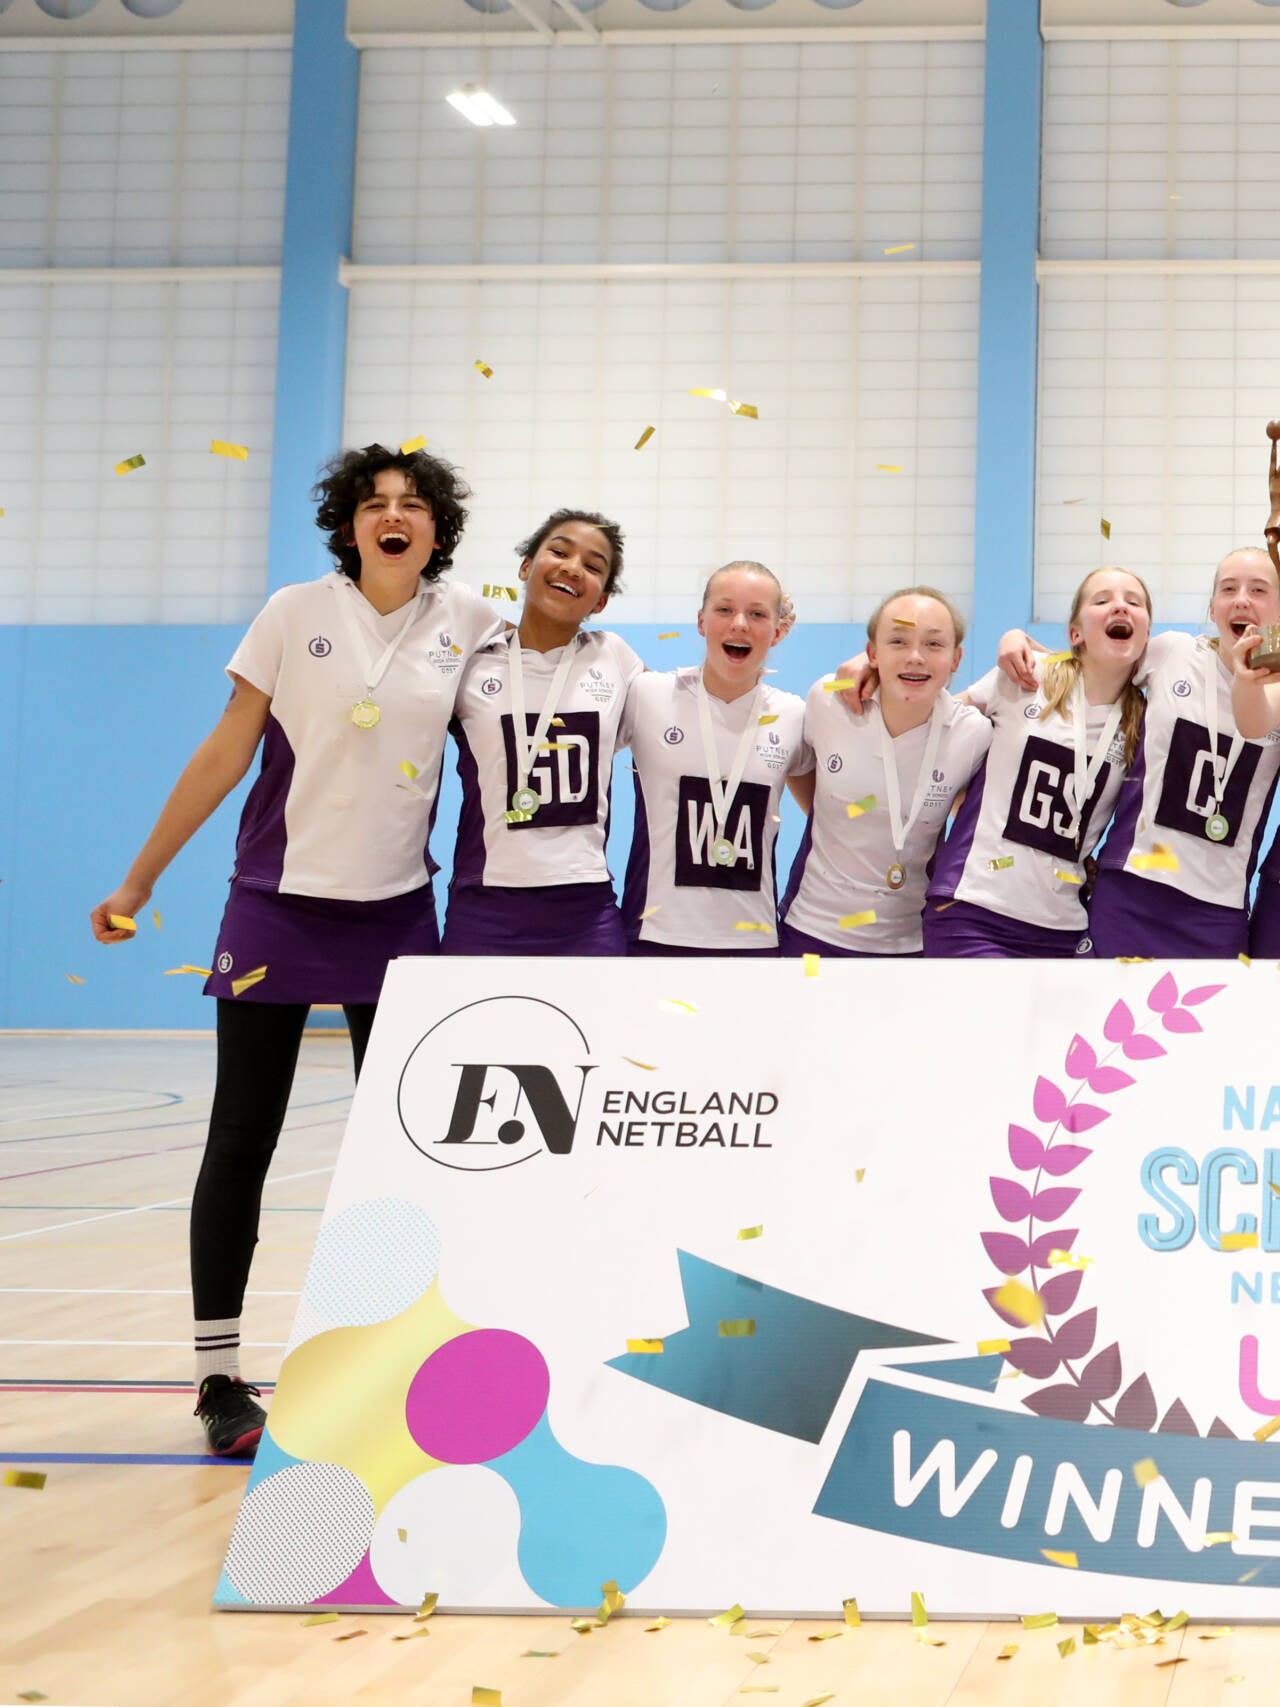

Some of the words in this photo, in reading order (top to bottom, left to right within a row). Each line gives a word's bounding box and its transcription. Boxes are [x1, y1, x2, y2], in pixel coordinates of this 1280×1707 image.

[428, 650, 462, 658] PUTN
[688, 800, 755, 870] WA
[603, 1090, 779, 1115] ENGLAND
[596, 1121, 773, 1148] NETBALL
